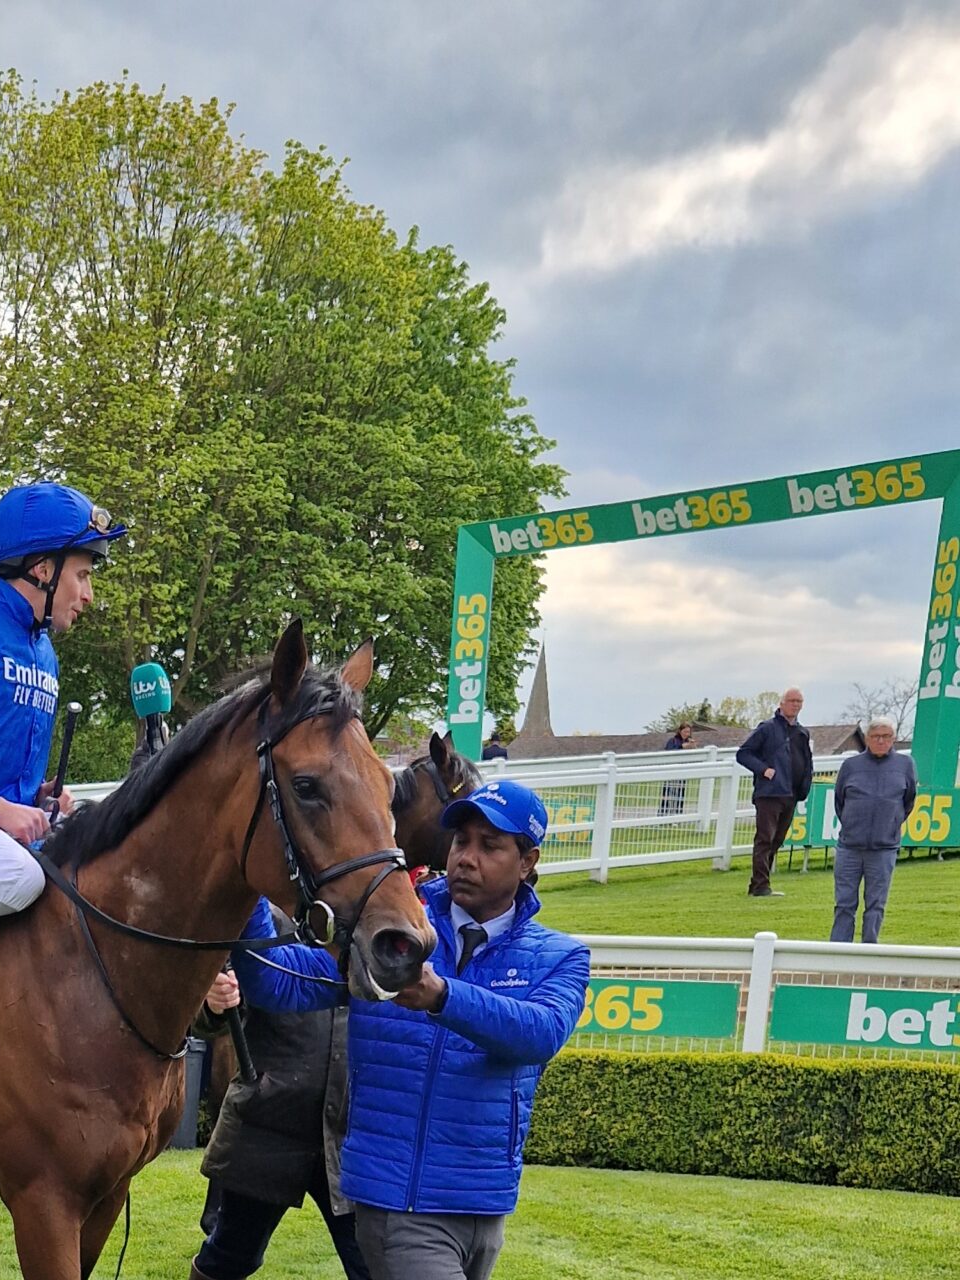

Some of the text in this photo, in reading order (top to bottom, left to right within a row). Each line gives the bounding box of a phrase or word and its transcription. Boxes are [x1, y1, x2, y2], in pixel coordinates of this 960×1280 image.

[632, 489, 752, 536] bet365
[787, 461, 926, 514] bet365
[489, 512, 594, 553] bet365
[918, 536, 960, 700] bet365
[450, 593, 487, 724] bet365
[13, 684, 31, 706] FLY
[133, 680, 157, 695] itv
[845, 992, 960, 1047] bet
